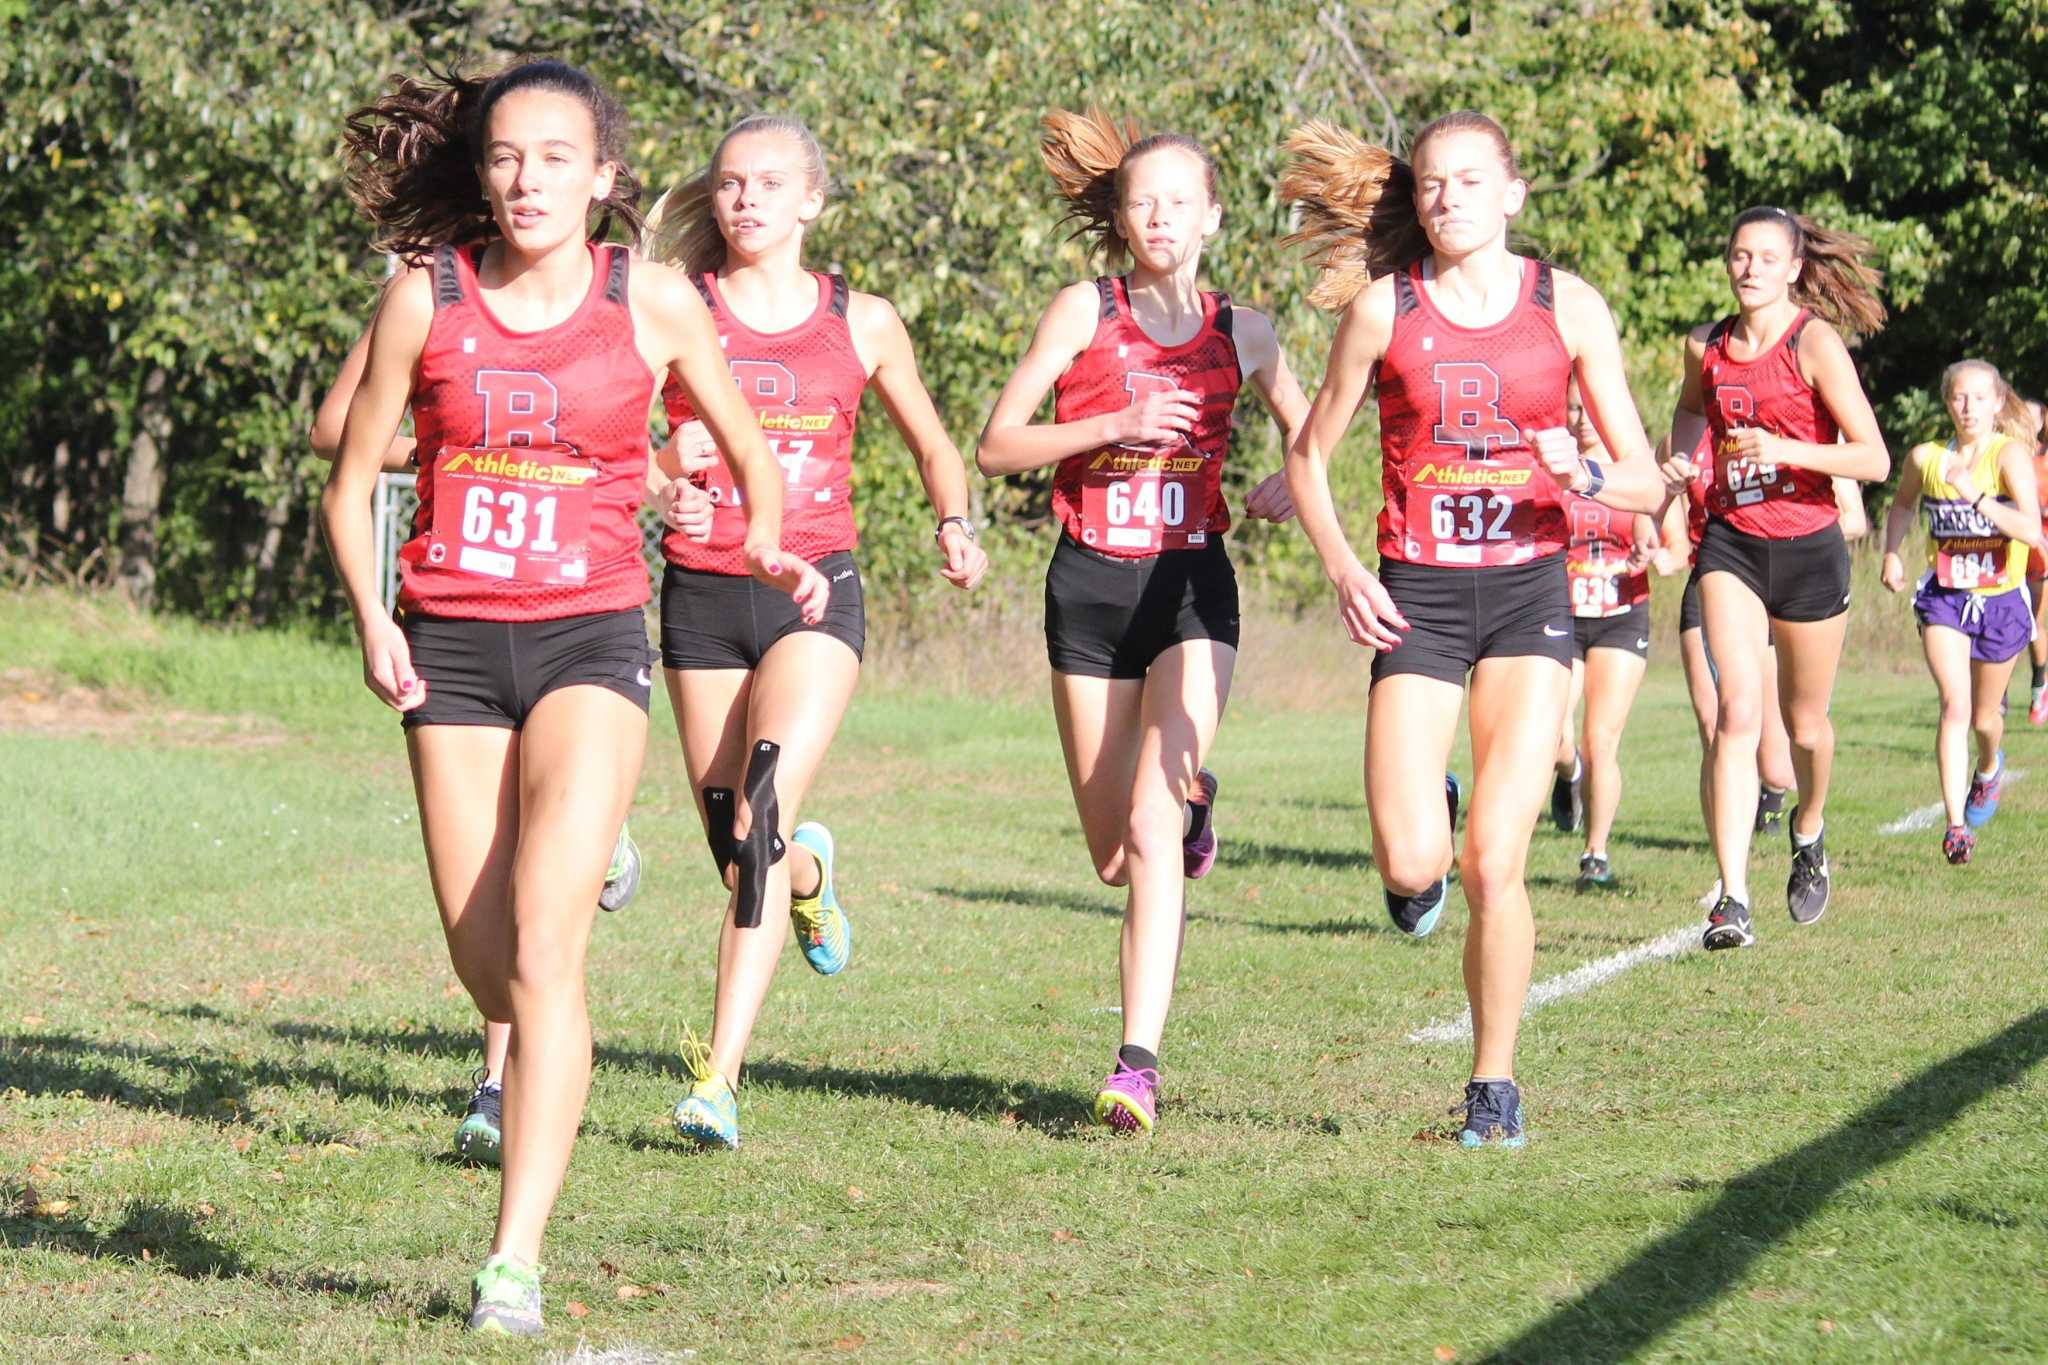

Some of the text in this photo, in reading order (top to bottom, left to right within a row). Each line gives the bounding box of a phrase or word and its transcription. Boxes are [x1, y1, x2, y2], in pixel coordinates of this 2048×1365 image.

[462, 486, 557, 552] 631
[1107, 481, 1184, 526] 640
[1431, 494, 1513, 541] 632
[713, 792, 724, 800] KT
